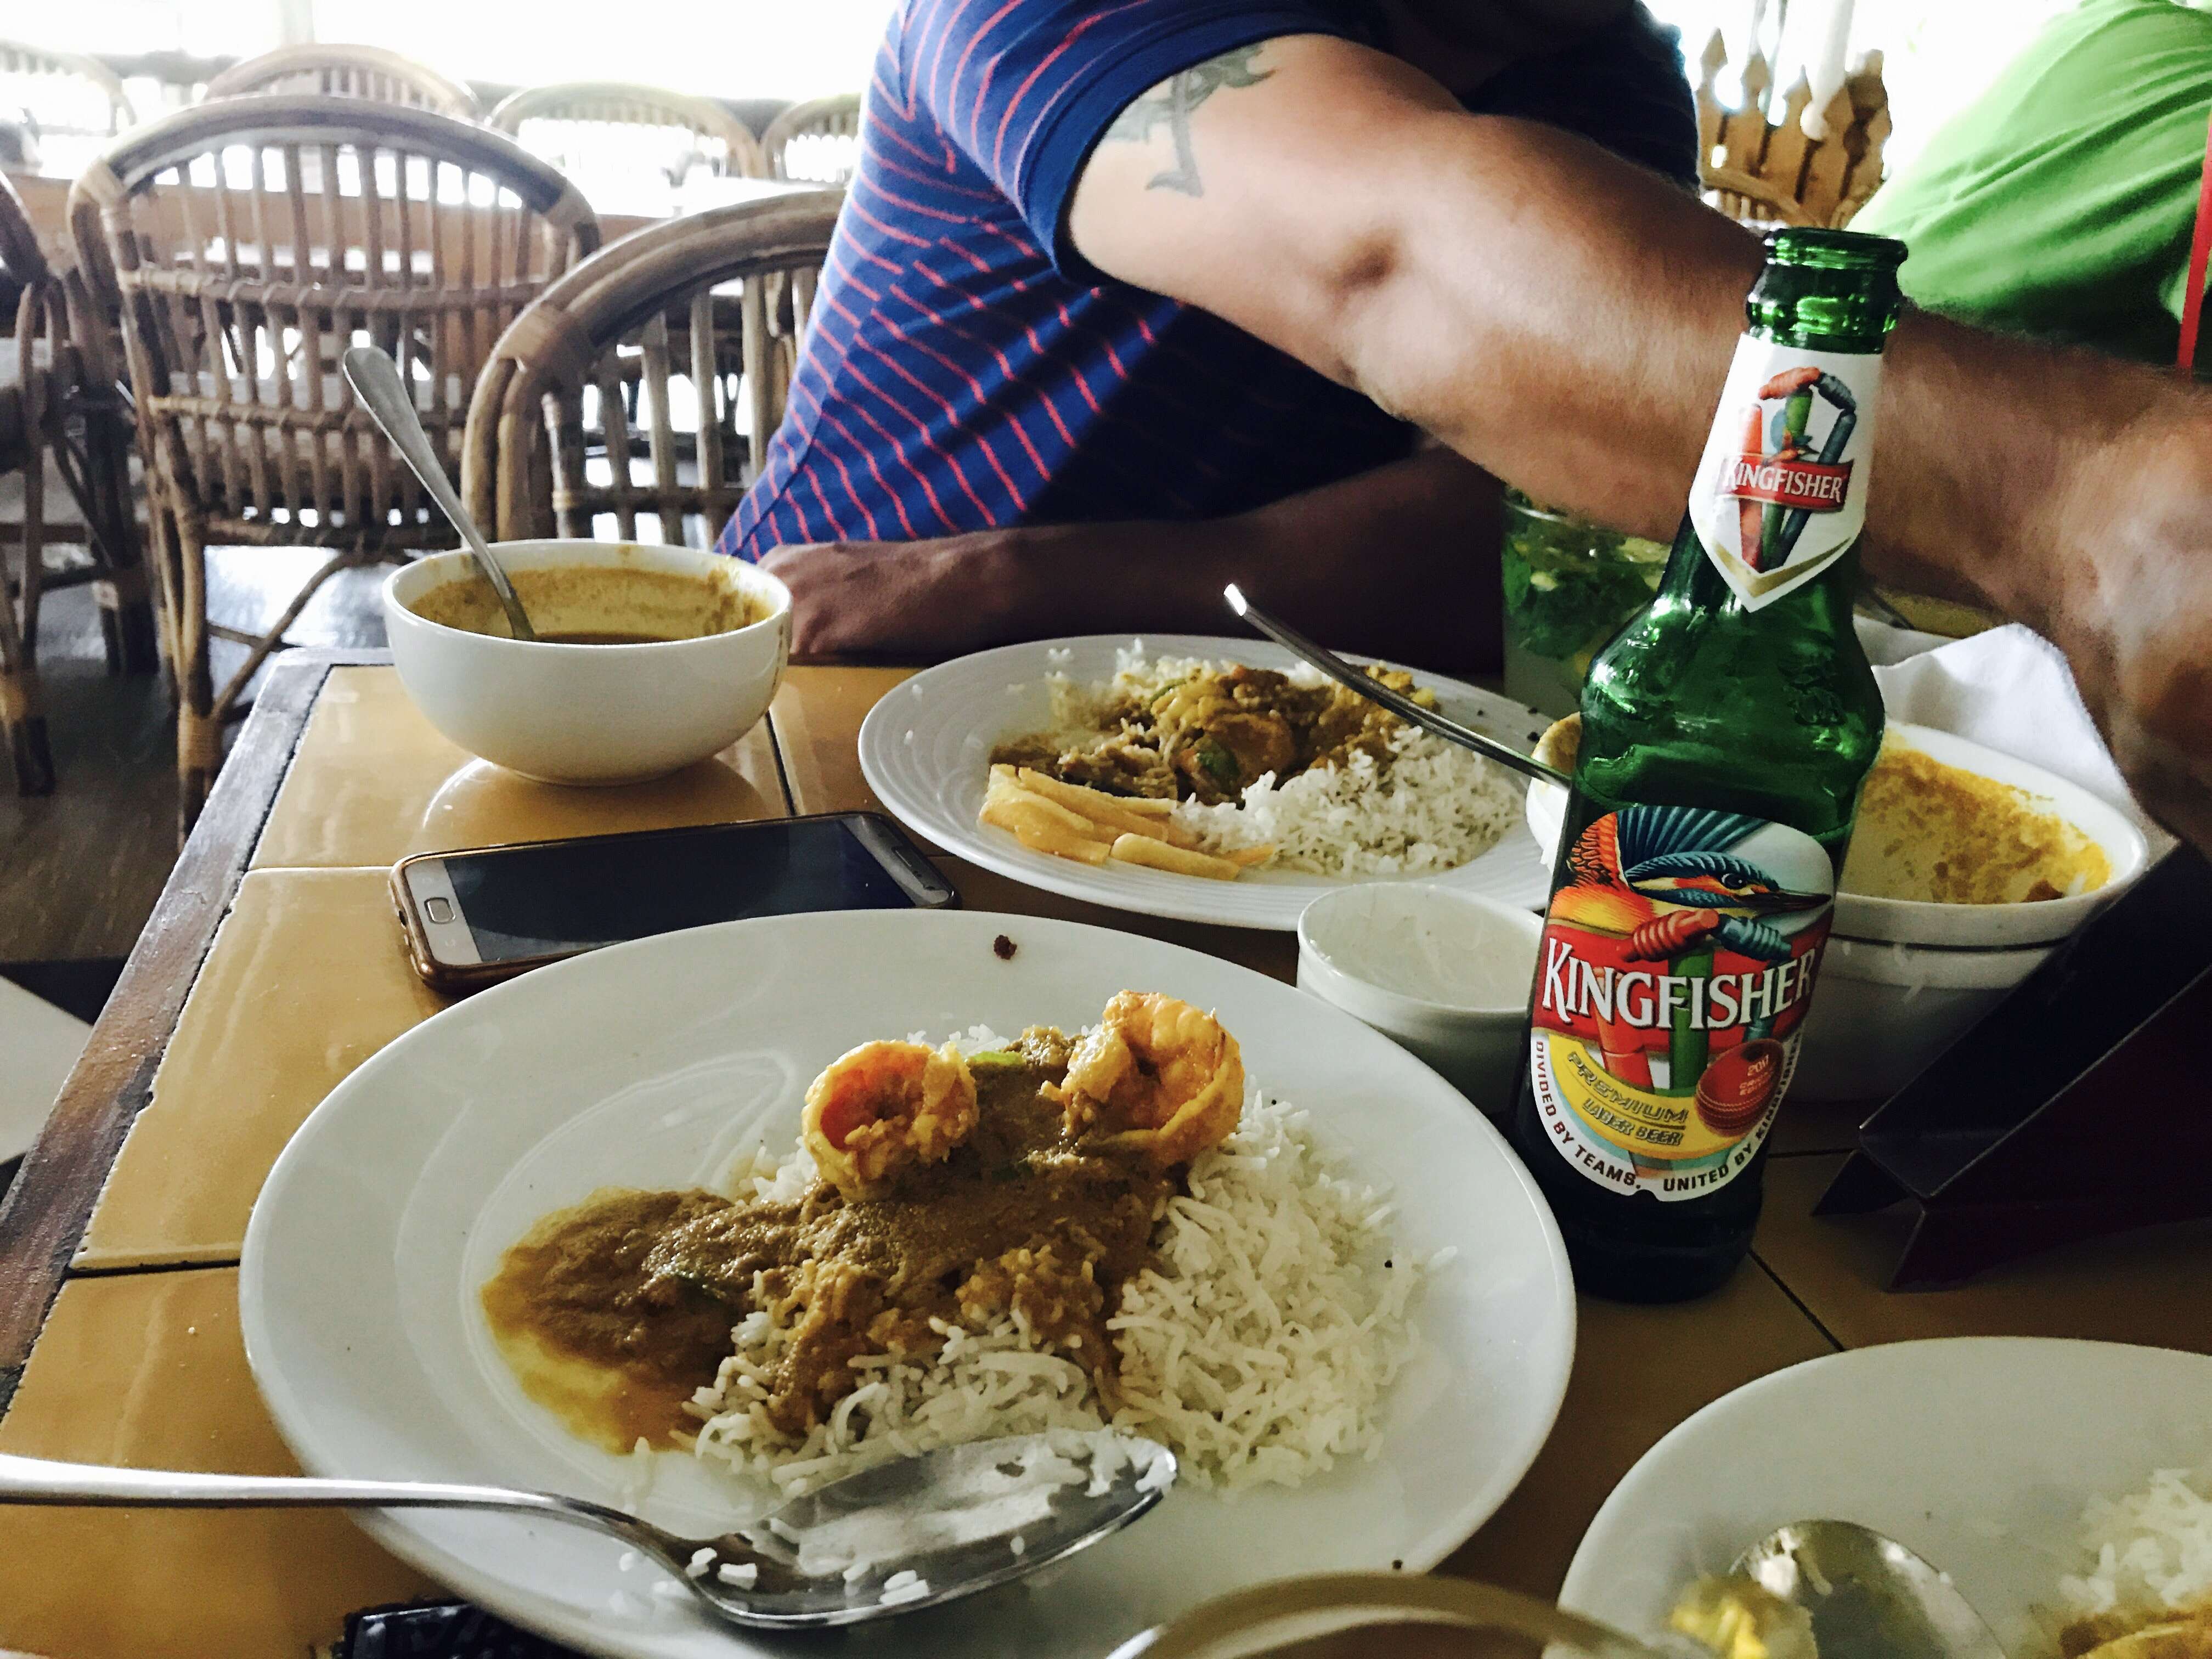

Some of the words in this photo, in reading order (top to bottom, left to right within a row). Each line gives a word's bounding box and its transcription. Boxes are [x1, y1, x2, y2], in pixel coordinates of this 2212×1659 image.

[1724, 460, 1843, 503] KINGFISHER
[1542, 938, 1816, 1029] KINGFISHER
[1567, 1051, 1689, 1124] PREMIUM
[1747, 1054, 1769, 1076] 2017
[1536, 1041, 1556, 1116] DIVIDED
[1553, 1120, 1575, 1144] BY
[1663, 1164, 1729, 1192] UNITED
[1734, 1143, 1752, 1165] BY
[1635, 1126, 1684, 1146] BEER
